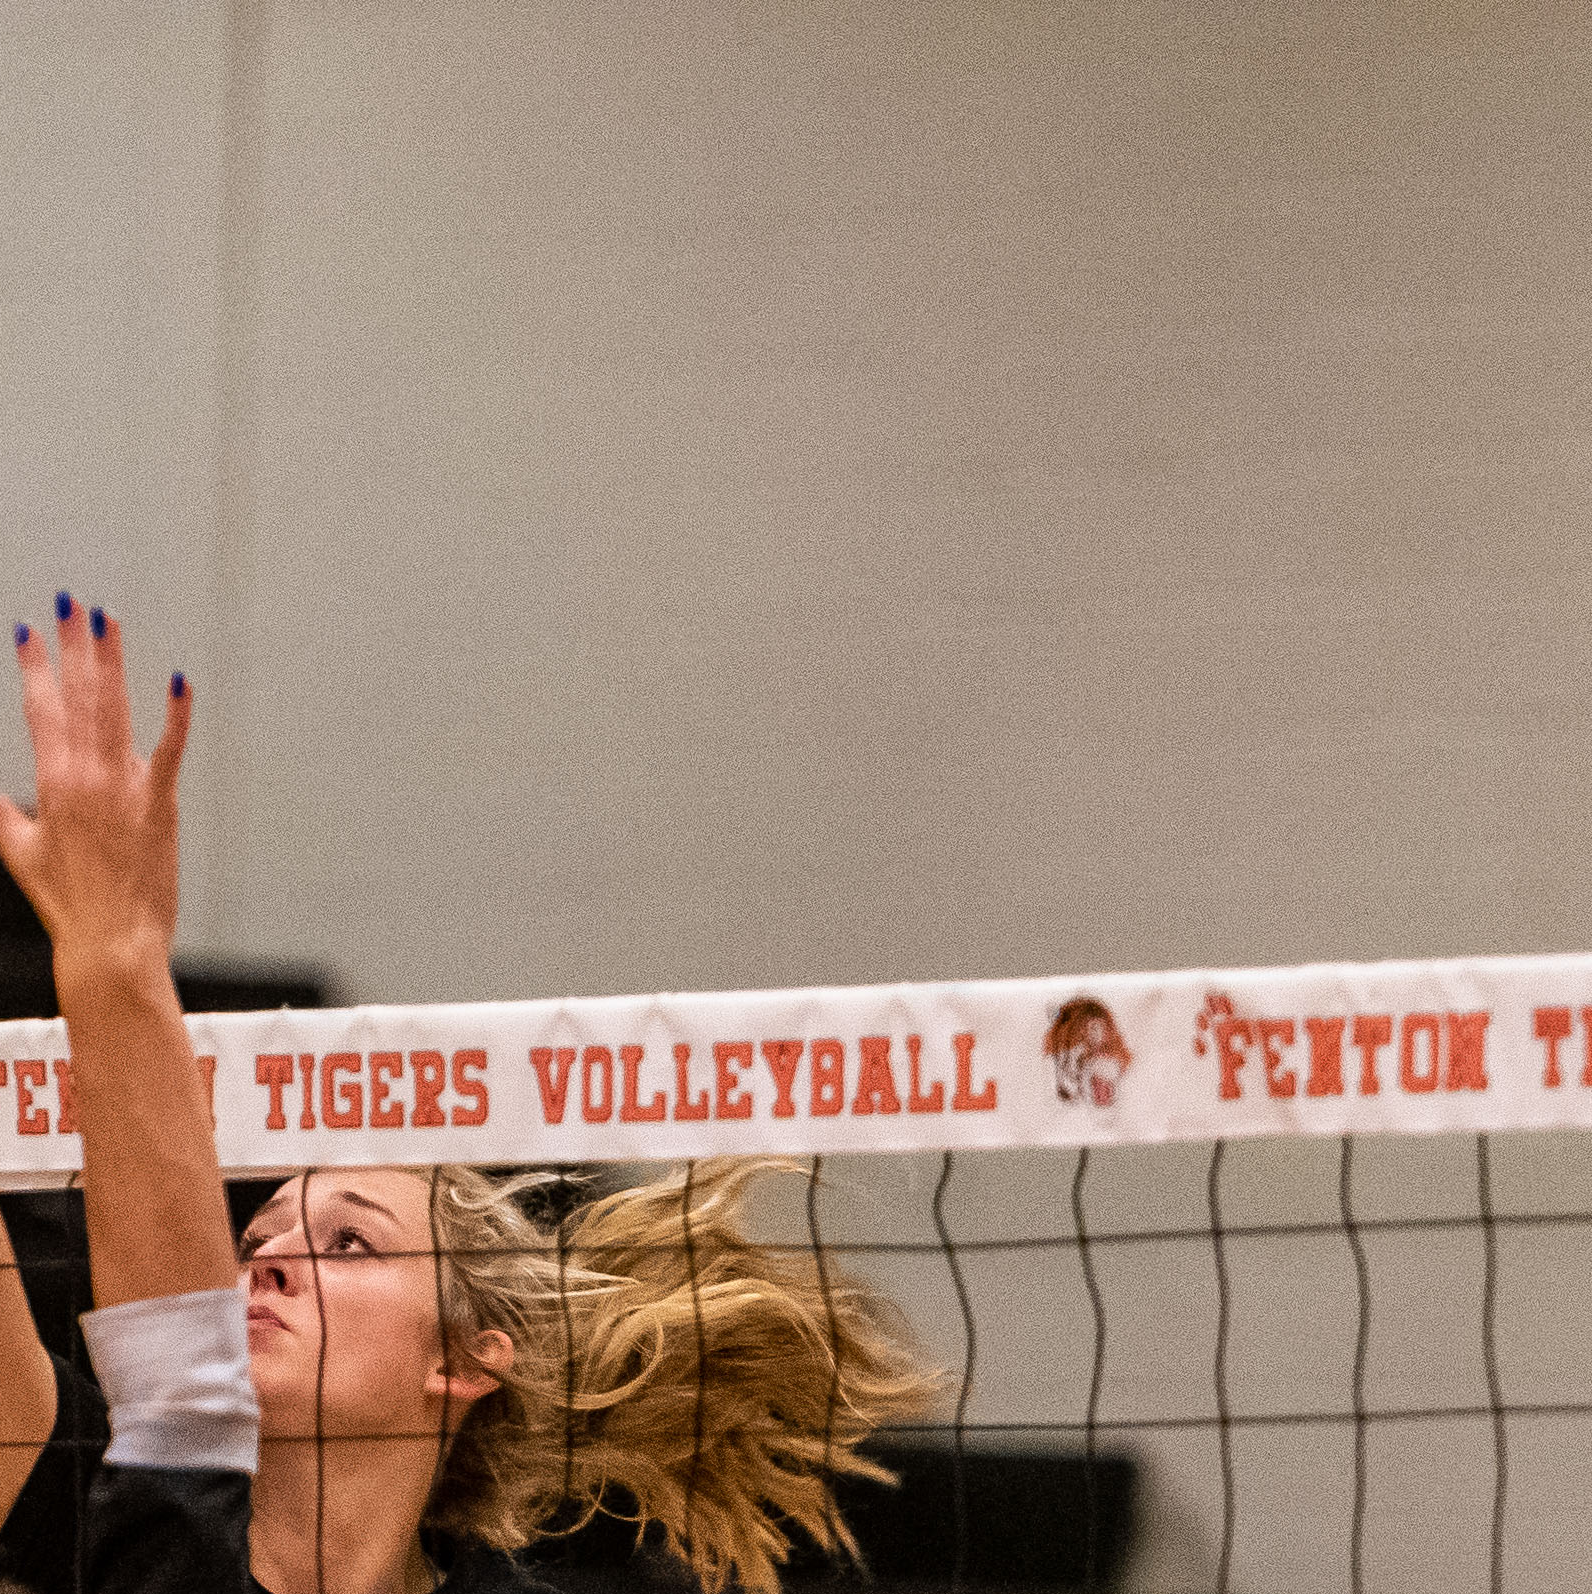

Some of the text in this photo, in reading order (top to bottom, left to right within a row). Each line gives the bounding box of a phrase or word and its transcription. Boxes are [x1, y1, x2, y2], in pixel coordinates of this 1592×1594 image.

[254, 1049, 488, 1130] TIGERS
[529, 1033, 997, 1125] VOLLEYBALL
[1216, 1011, 1490, 1100] FENTON
